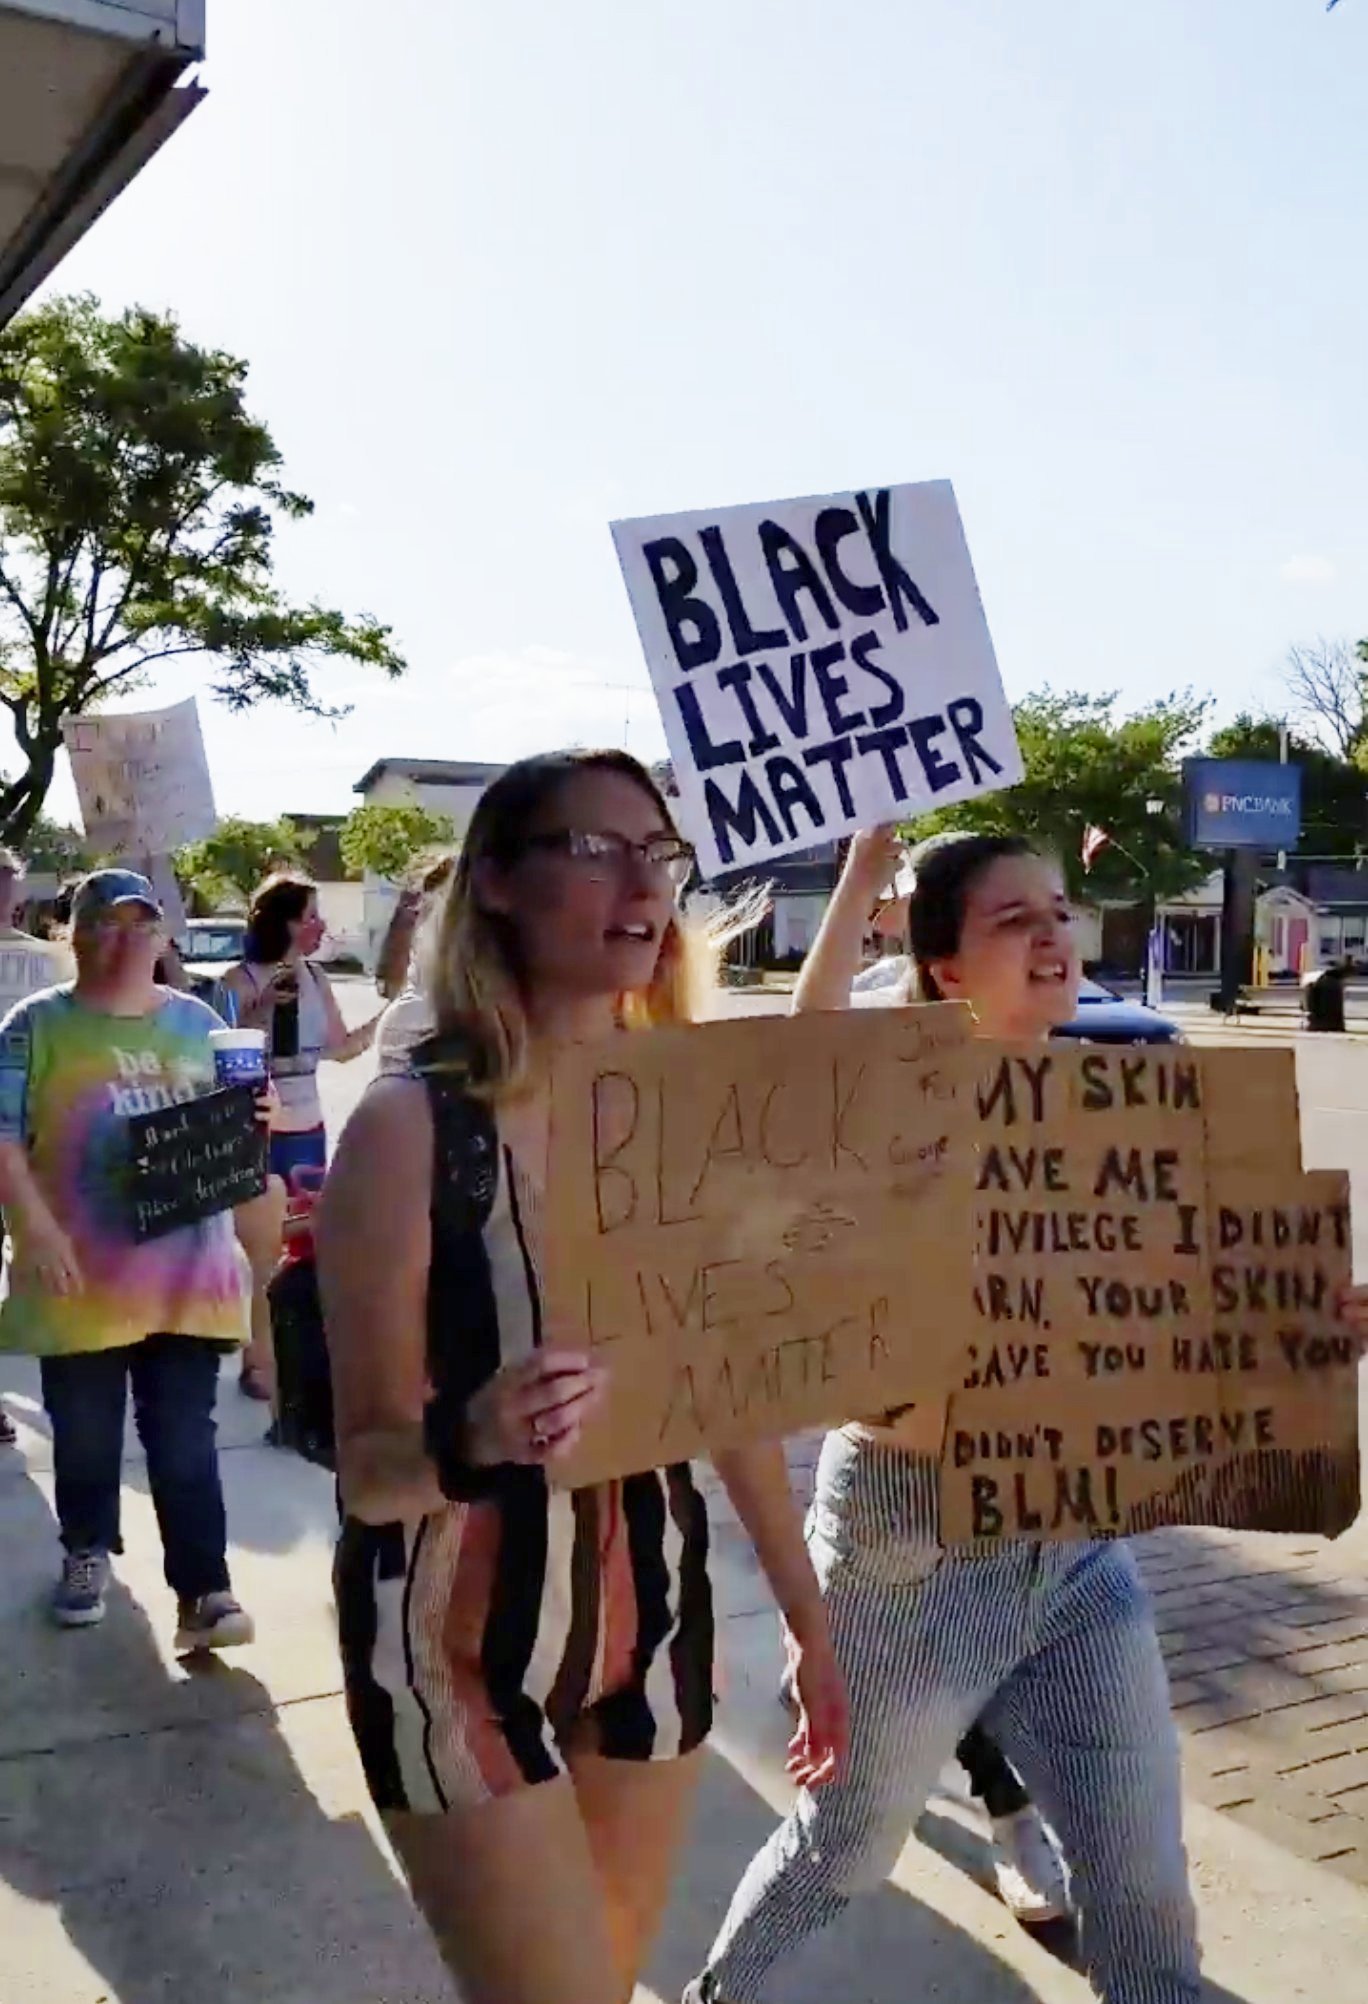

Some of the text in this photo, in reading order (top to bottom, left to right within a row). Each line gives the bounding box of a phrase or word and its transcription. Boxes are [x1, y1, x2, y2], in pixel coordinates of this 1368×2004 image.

[643, 489, 939, 672] BLACK
[673, 630, 904, 771] LIVES
[704, 697, 1003, 864] MATTER
[1081, 1055, 1199, 1111] SKIN
[592, 1062, 869, 1235] BLACK
[975, 1146, 1068, 1191] AVE
[1094, 1145, 1179, 1202] ME
[977, 1208, 1142, 1255] IVILEGE
[1173, 1206, 1198, 1254] I
[587, 1259, 794, 1345] LIVES
[1078, 1276, 1187, 1317] YOUR
[1079, 1341, 1145, 1379] YOU
[1172, 1328, 1259, 1373] HATE
[954, 1407, 1275, 1468] DIDN'T DESERVE
[971, 1466, 1120, 1538] BLM!
